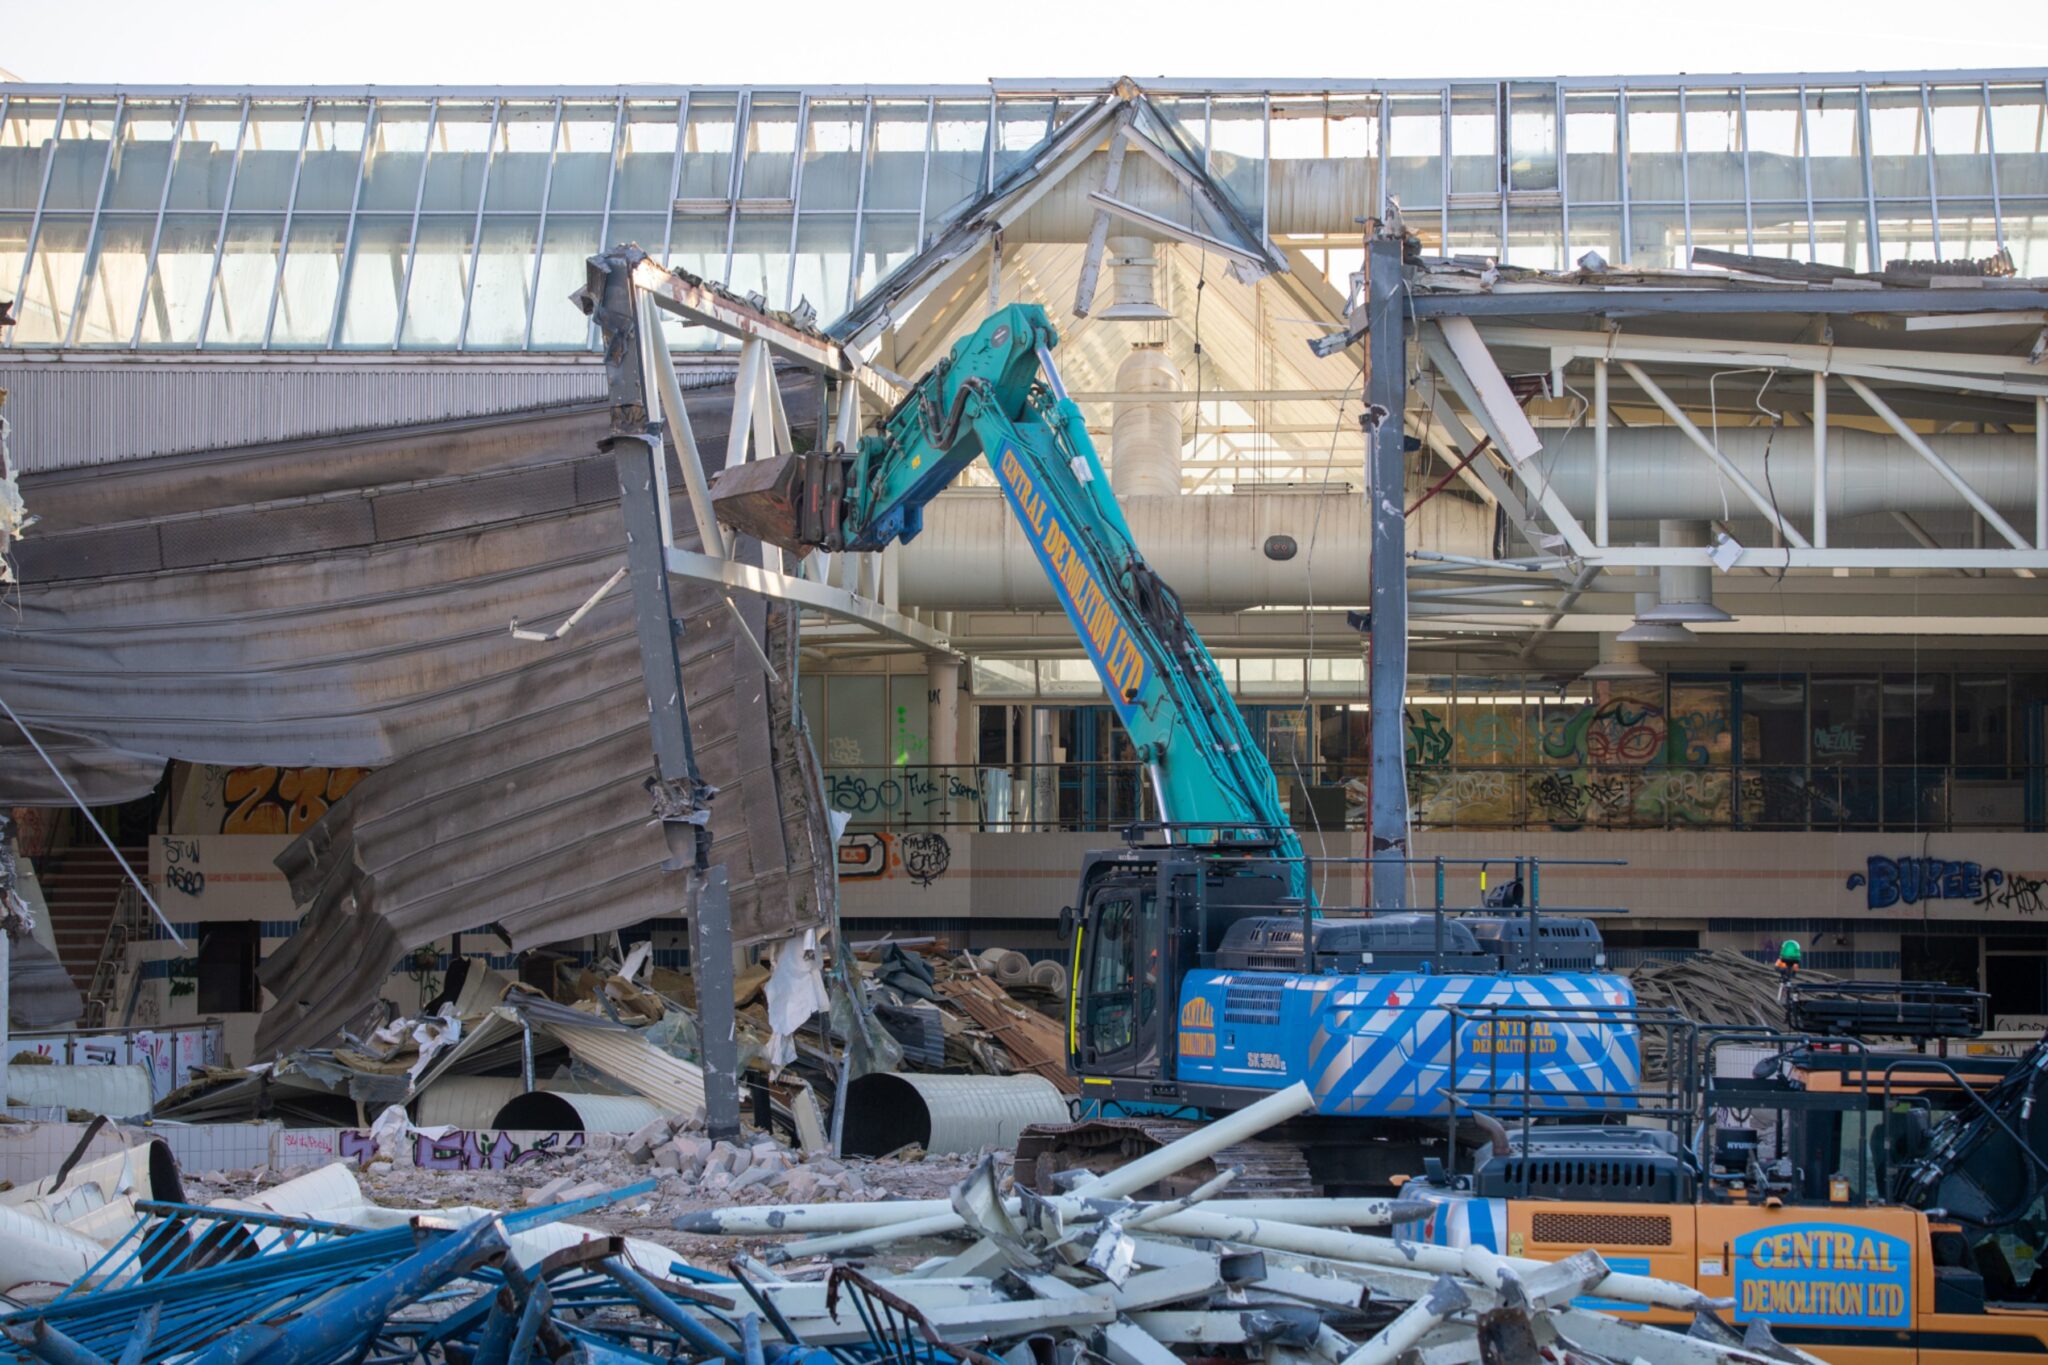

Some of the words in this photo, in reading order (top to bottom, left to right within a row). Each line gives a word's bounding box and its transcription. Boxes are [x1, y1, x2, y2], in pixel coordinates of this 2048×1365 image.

[1001, 449, 1047, 537] CENTRAL
[1043, 518, 1120, 656] DEMOLITION
[1105, 627, 1146, 704] LTD
[1182, 997, 1214, 1028] CENTRAL
[1539, 1039, 1557, 1053] LTD
[1752, 1230, 1897, 1272] CENTRAL
[1741, 1280, 1864, 1315] DEMOLITION
[1867, 1283, 1904, 1317] LTD
